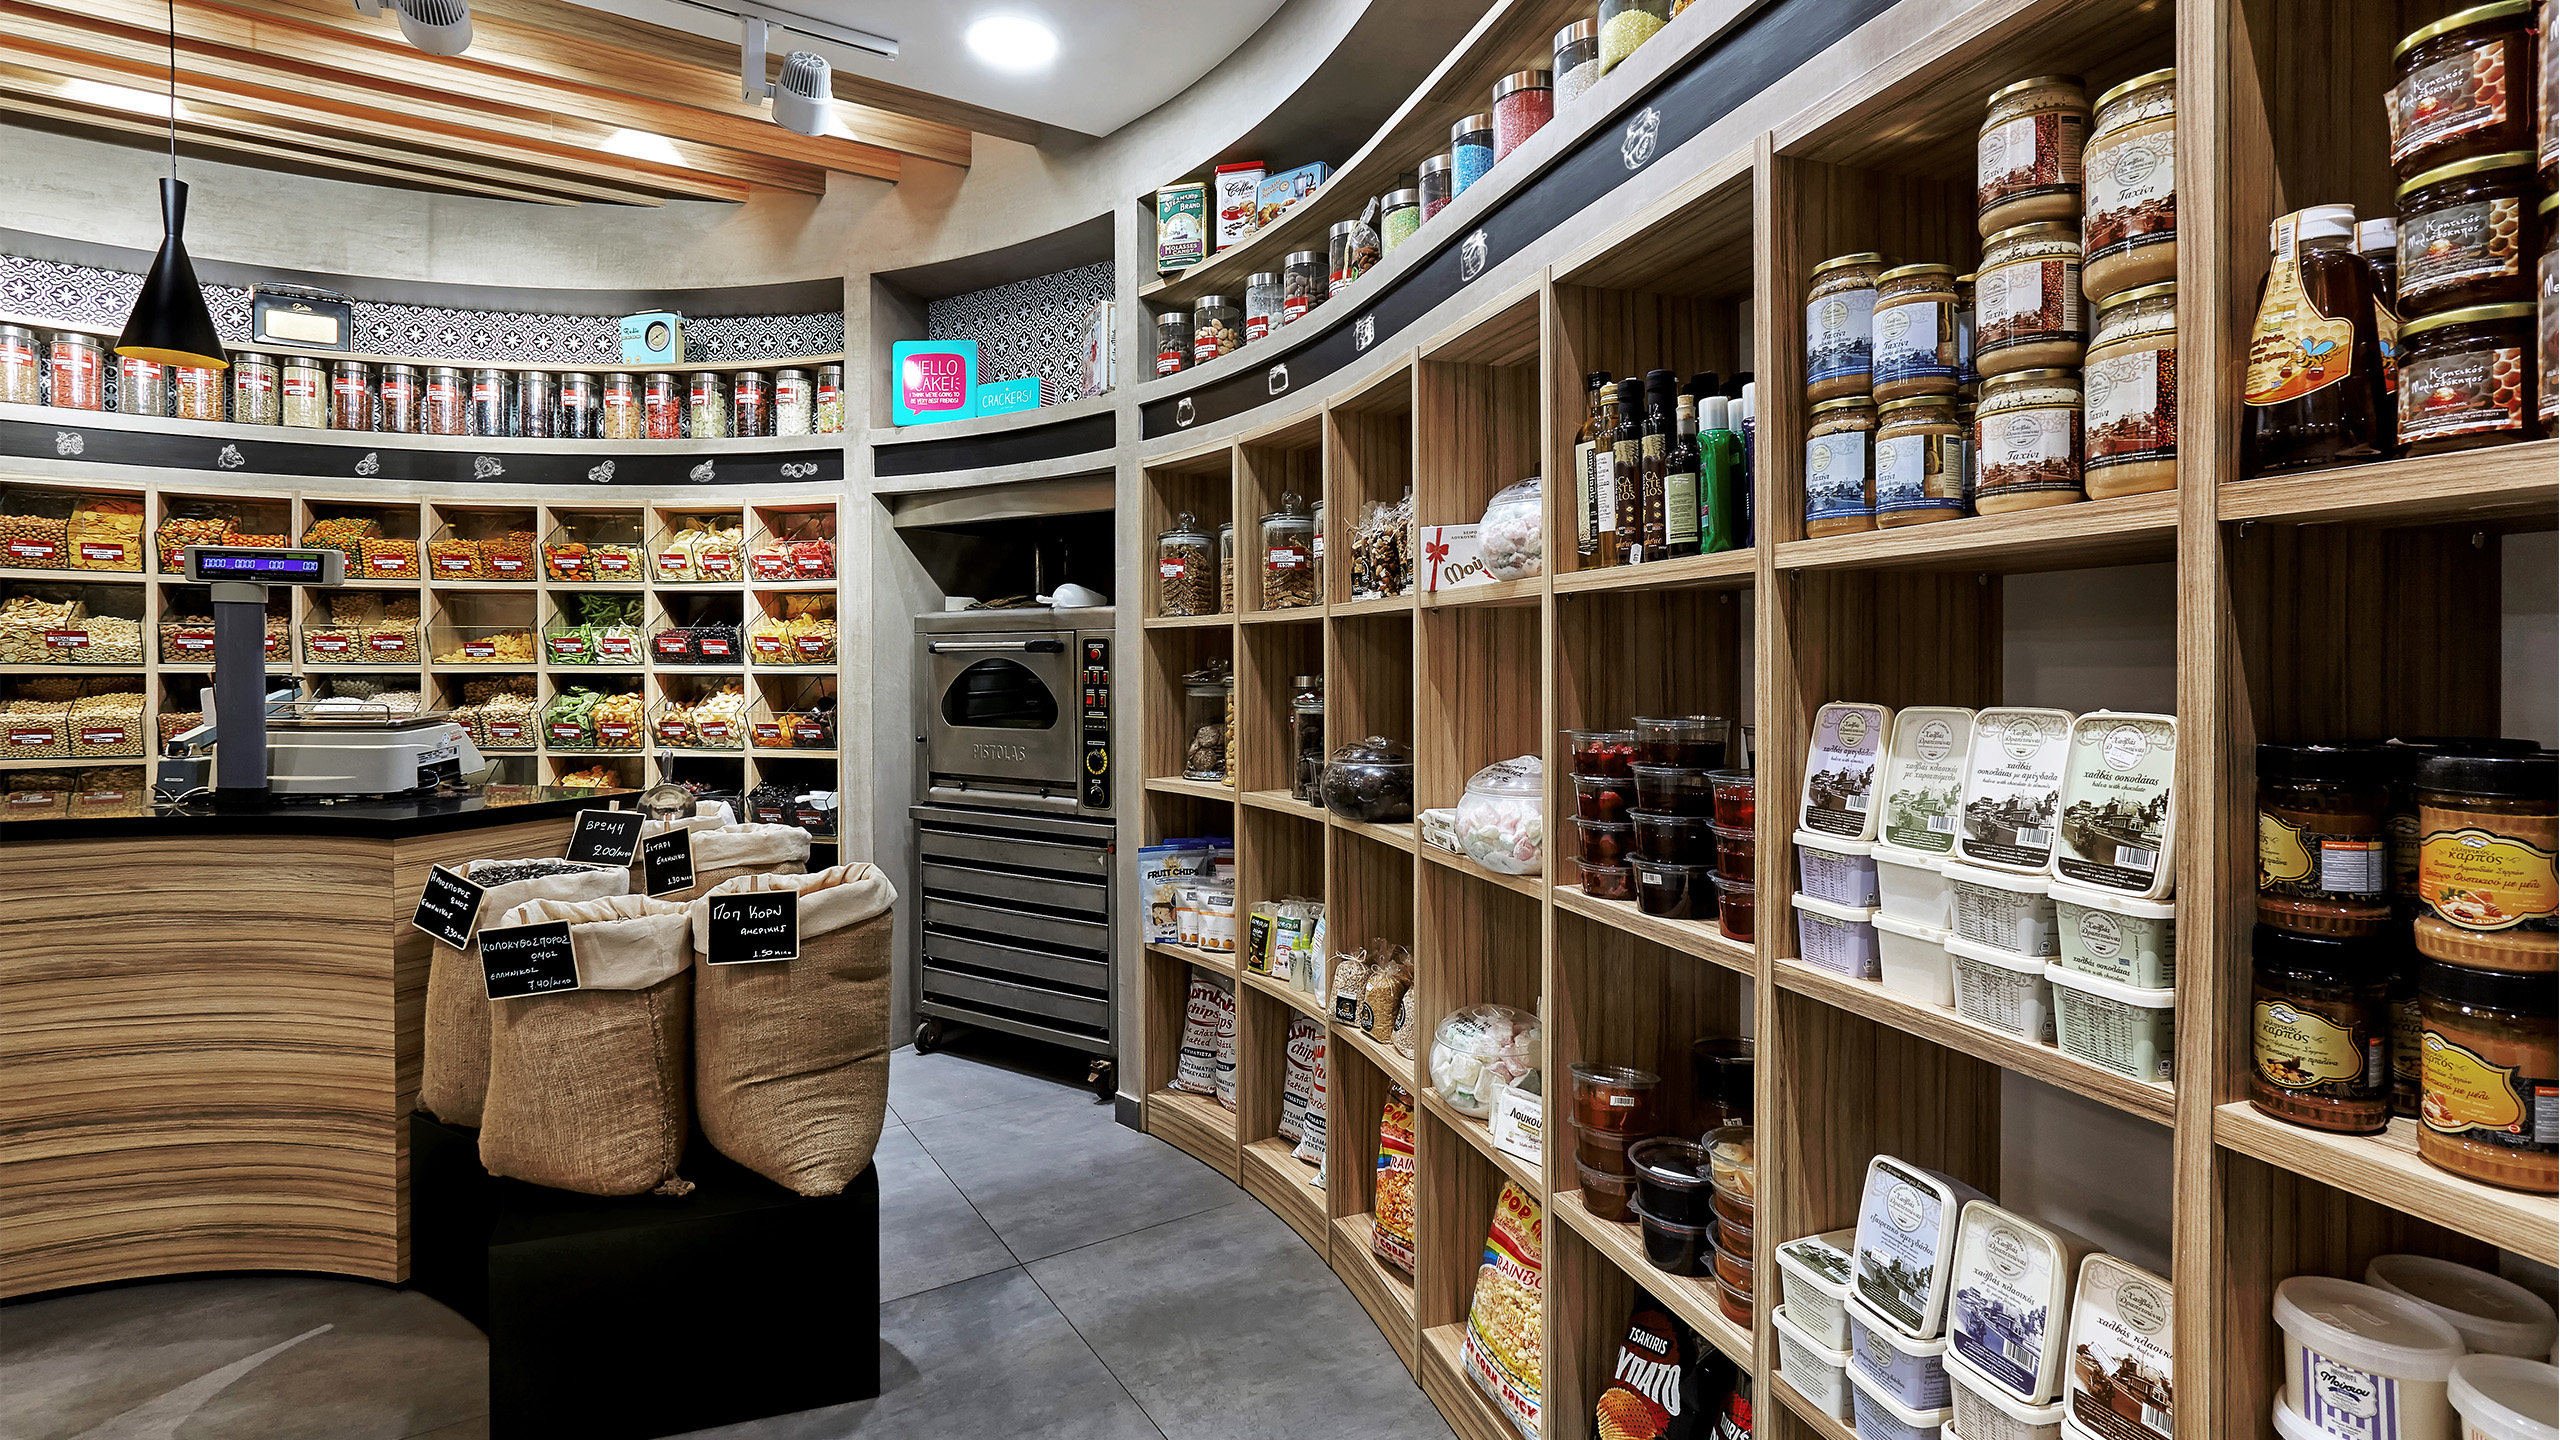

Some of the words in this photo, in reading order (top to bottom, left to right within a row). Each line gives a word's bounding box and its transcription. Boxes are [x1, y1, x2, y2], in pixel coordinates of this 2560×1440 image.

[1225, 180, 1254, 197] Coffee
[2116, 185, 2155, 202] Ταχίνι
[982, 390, 1032, 408] CRACKERS!
[2006, 450, 2040, 461] Ταχίνι
[973, 743, 1026, 762] PISTOLAS
[2448, 851, 2503, 865] καρπός
[1147, 869, 1171, 879] FRUIT
[1172, 868, 1199, 876] CHIPS
[2263, 1024, 2310, 1043] καρπός
[1501, 1189, 1532, 1220] POP
[1628, 1326, 1668, 1355] TSAKIRIS
[1614, 1345, 1681, 1417] ΥΠΑΤΟ
[1502, 1384, 1538, 1419] SPICY
